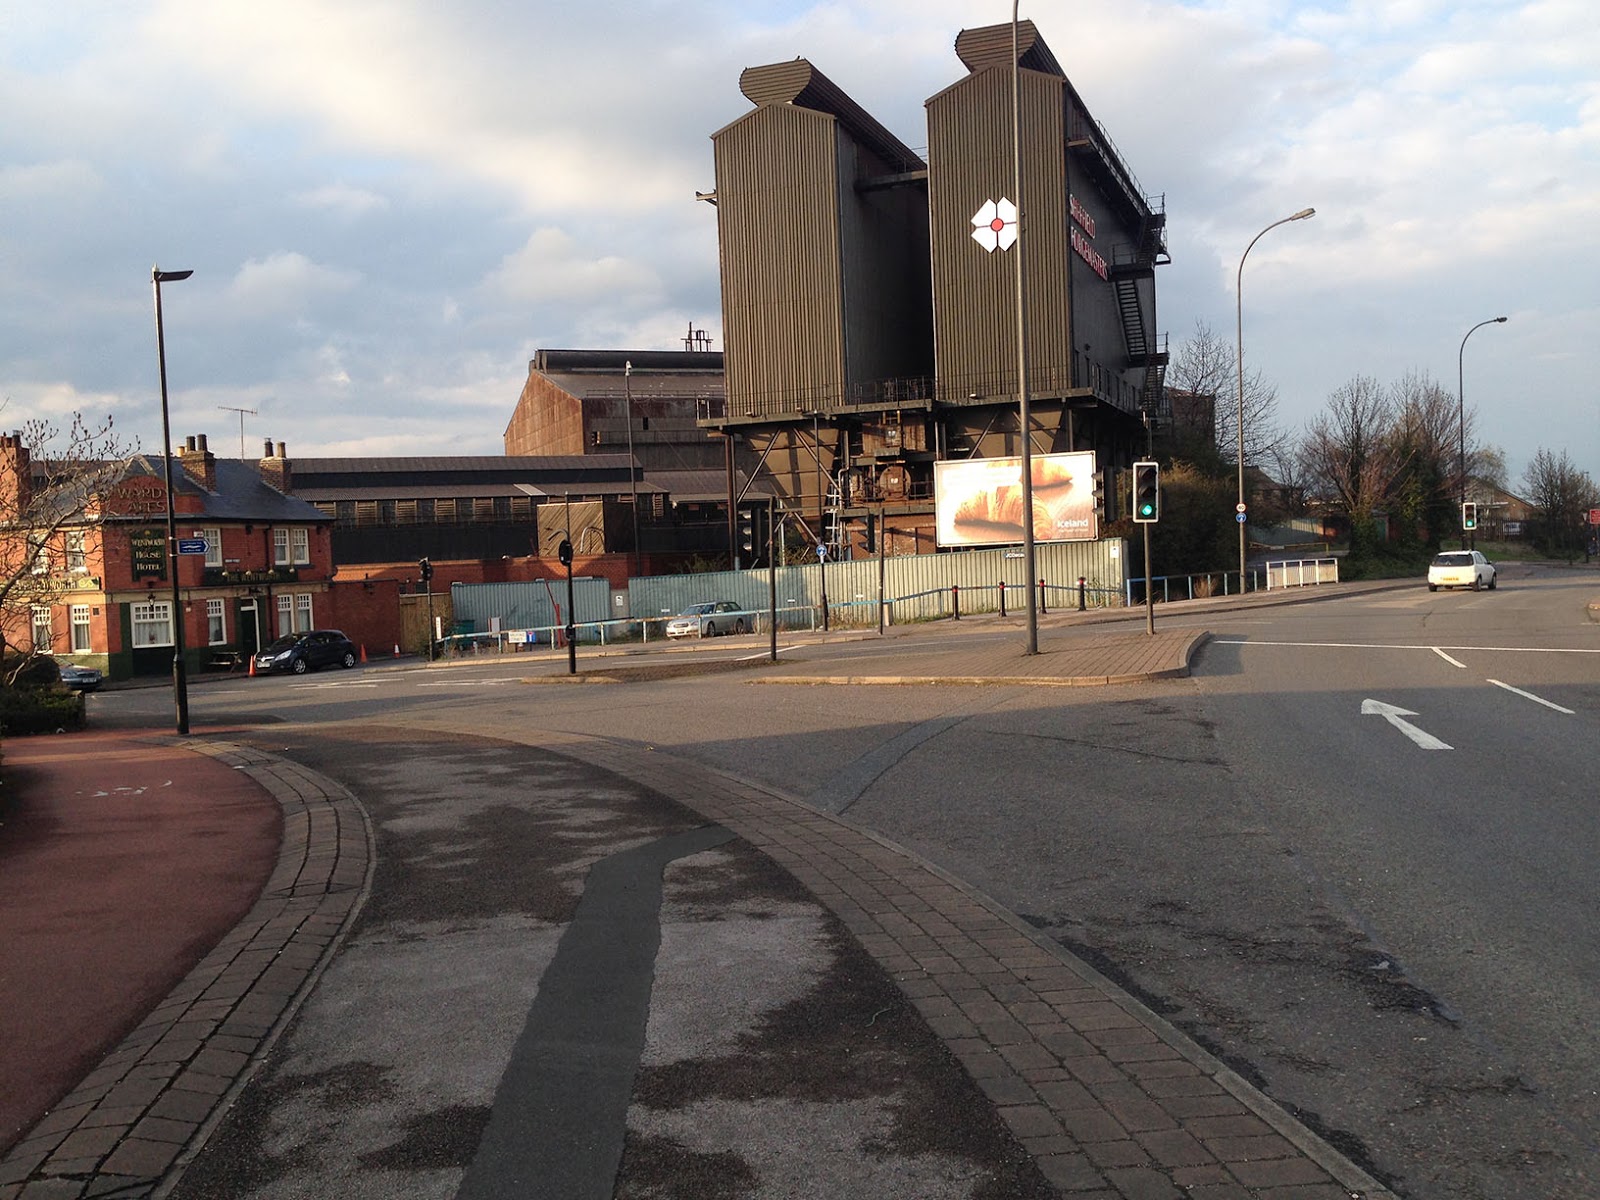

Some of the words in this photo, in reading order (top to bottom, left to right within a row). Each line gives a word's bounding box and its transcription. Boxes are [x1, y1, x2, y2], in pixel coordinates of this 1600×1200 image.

[117, 487, 164, 499] WARD
[1057, 517, 1088, 529] Iceland
[136, 563, 161, 571] HOTEL
